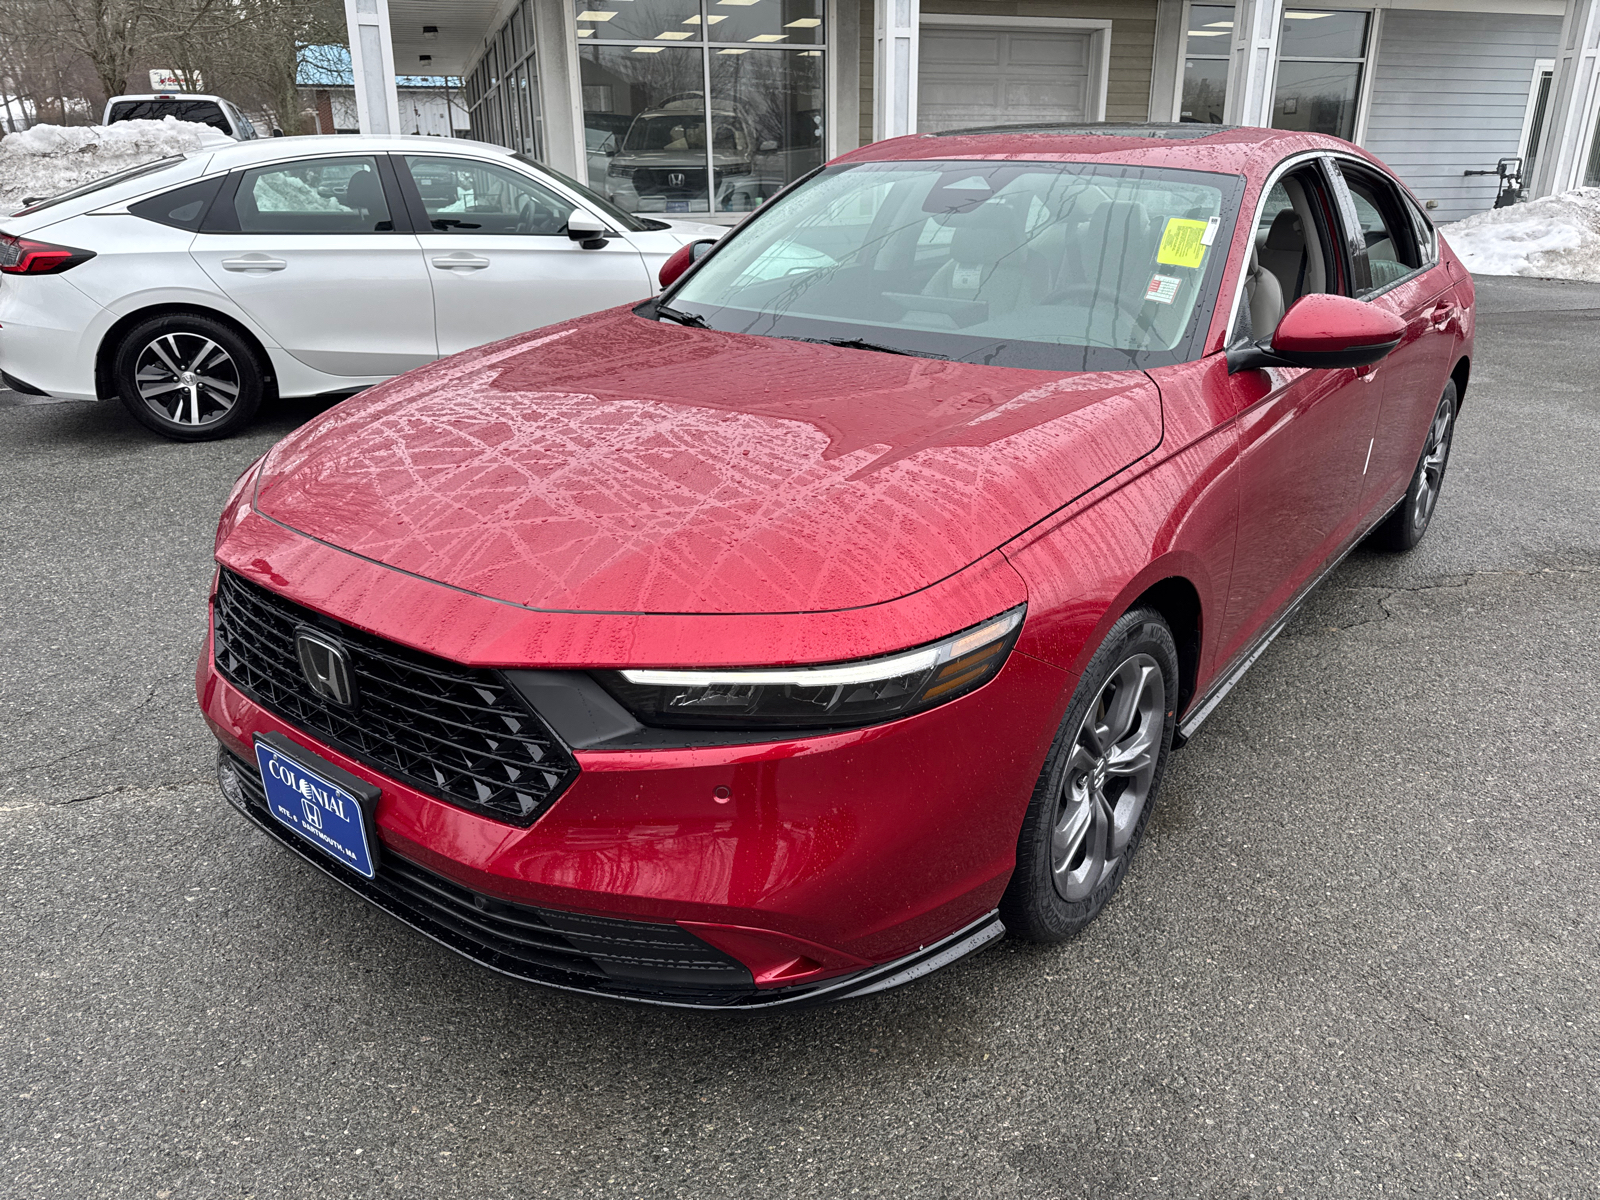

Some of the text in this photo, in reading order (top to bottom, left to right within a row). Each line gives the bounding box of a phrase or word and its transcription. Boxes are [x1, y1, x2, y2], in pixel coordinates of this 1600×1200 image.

[269, 760, 350, 822] COLONIAL
[278, 805, 292, 819] RTE.
[302, 820, 345, 854] DARTMOUTH,
[345, 848, 357, 860] MA
